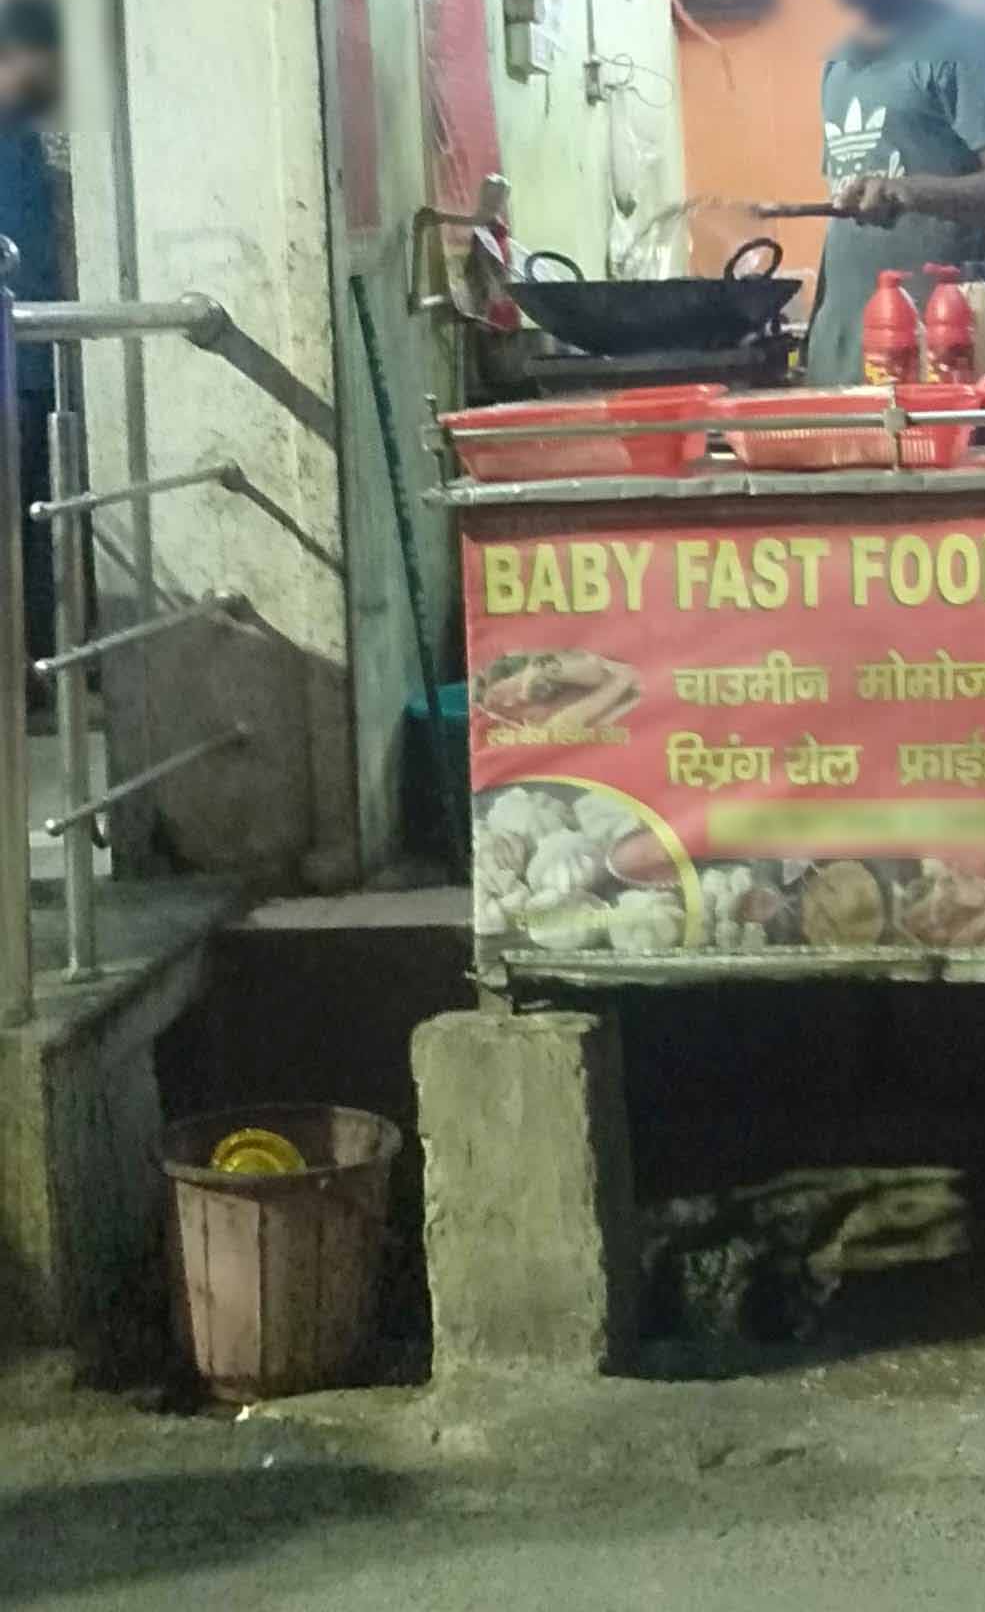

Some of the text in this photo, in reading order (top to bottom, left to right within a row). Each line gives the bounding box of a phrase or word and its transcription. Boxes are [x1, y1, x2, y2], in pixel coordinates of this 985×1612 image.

[483, 541, 654, 615] BABY
[675, 537, 830, 610] FAST
[673, 650, 830, 705] चाउमीन
[666, 730, 774, 790] स्प्रिंग
[785, 732, 863, 786] रोल
